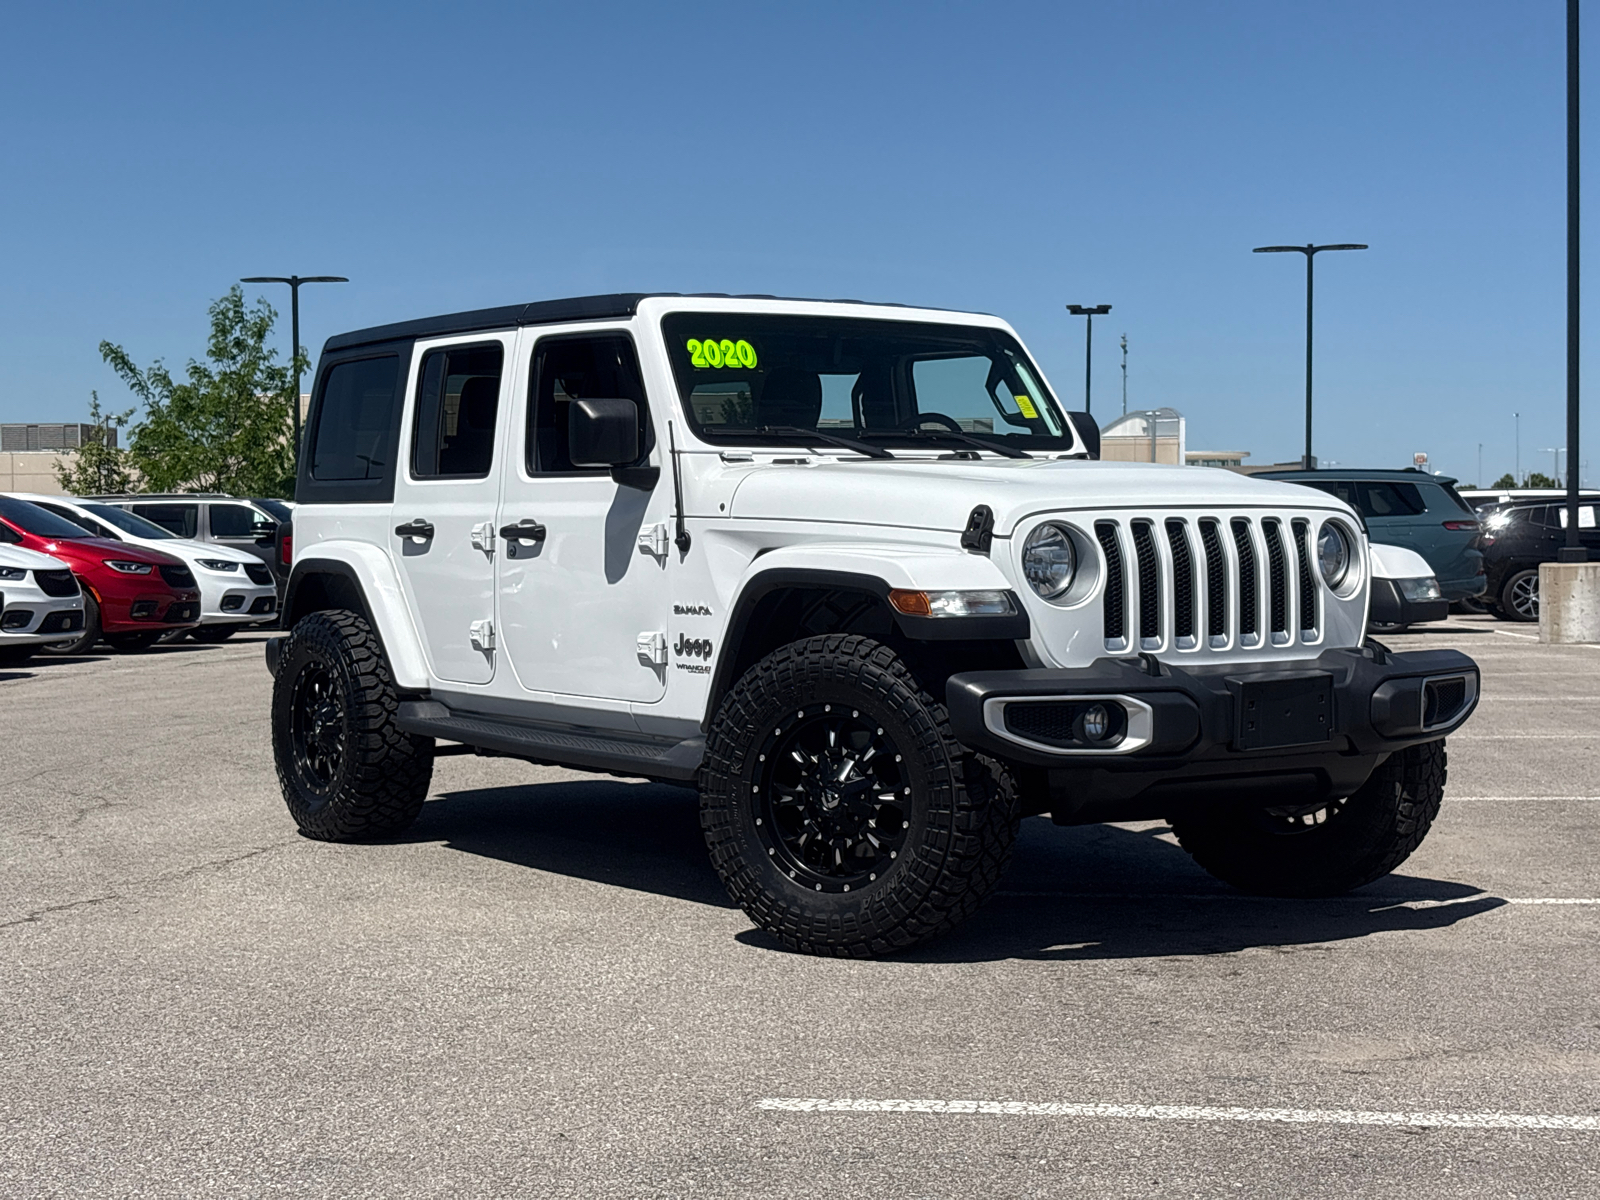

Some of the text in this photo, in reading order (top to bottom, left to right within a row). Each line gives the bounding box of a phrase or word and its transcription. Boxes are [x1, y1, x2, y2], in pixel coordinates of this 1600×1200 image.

[687, 339, 757, 368] 2020
[673, 632, 713, 662] Jeep
[862, 847, 917, 909] KENDA
